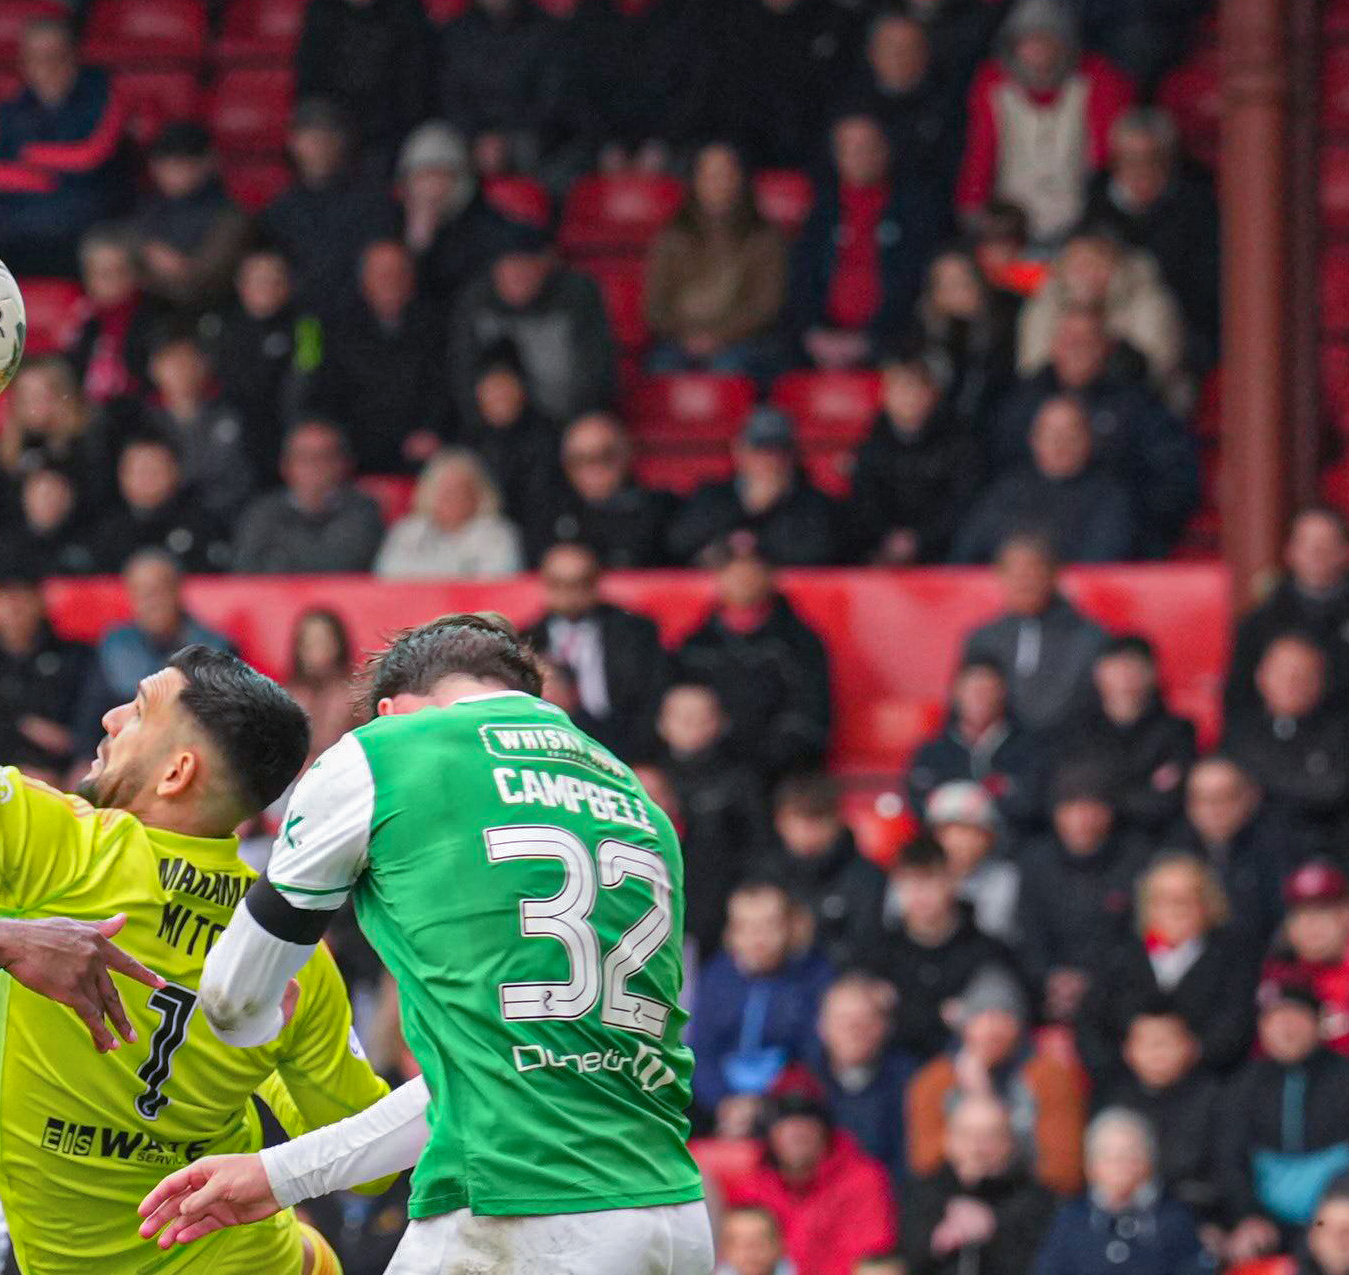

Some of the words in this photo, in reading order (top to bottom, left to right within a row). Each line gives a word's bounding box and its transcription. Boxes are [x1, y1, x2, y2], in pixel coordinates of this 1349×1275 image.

[493, 767, 658, 836] CAMPBELL
[483, 824, 674, 1041] 32
[134, 982, 200, 1121] 1
